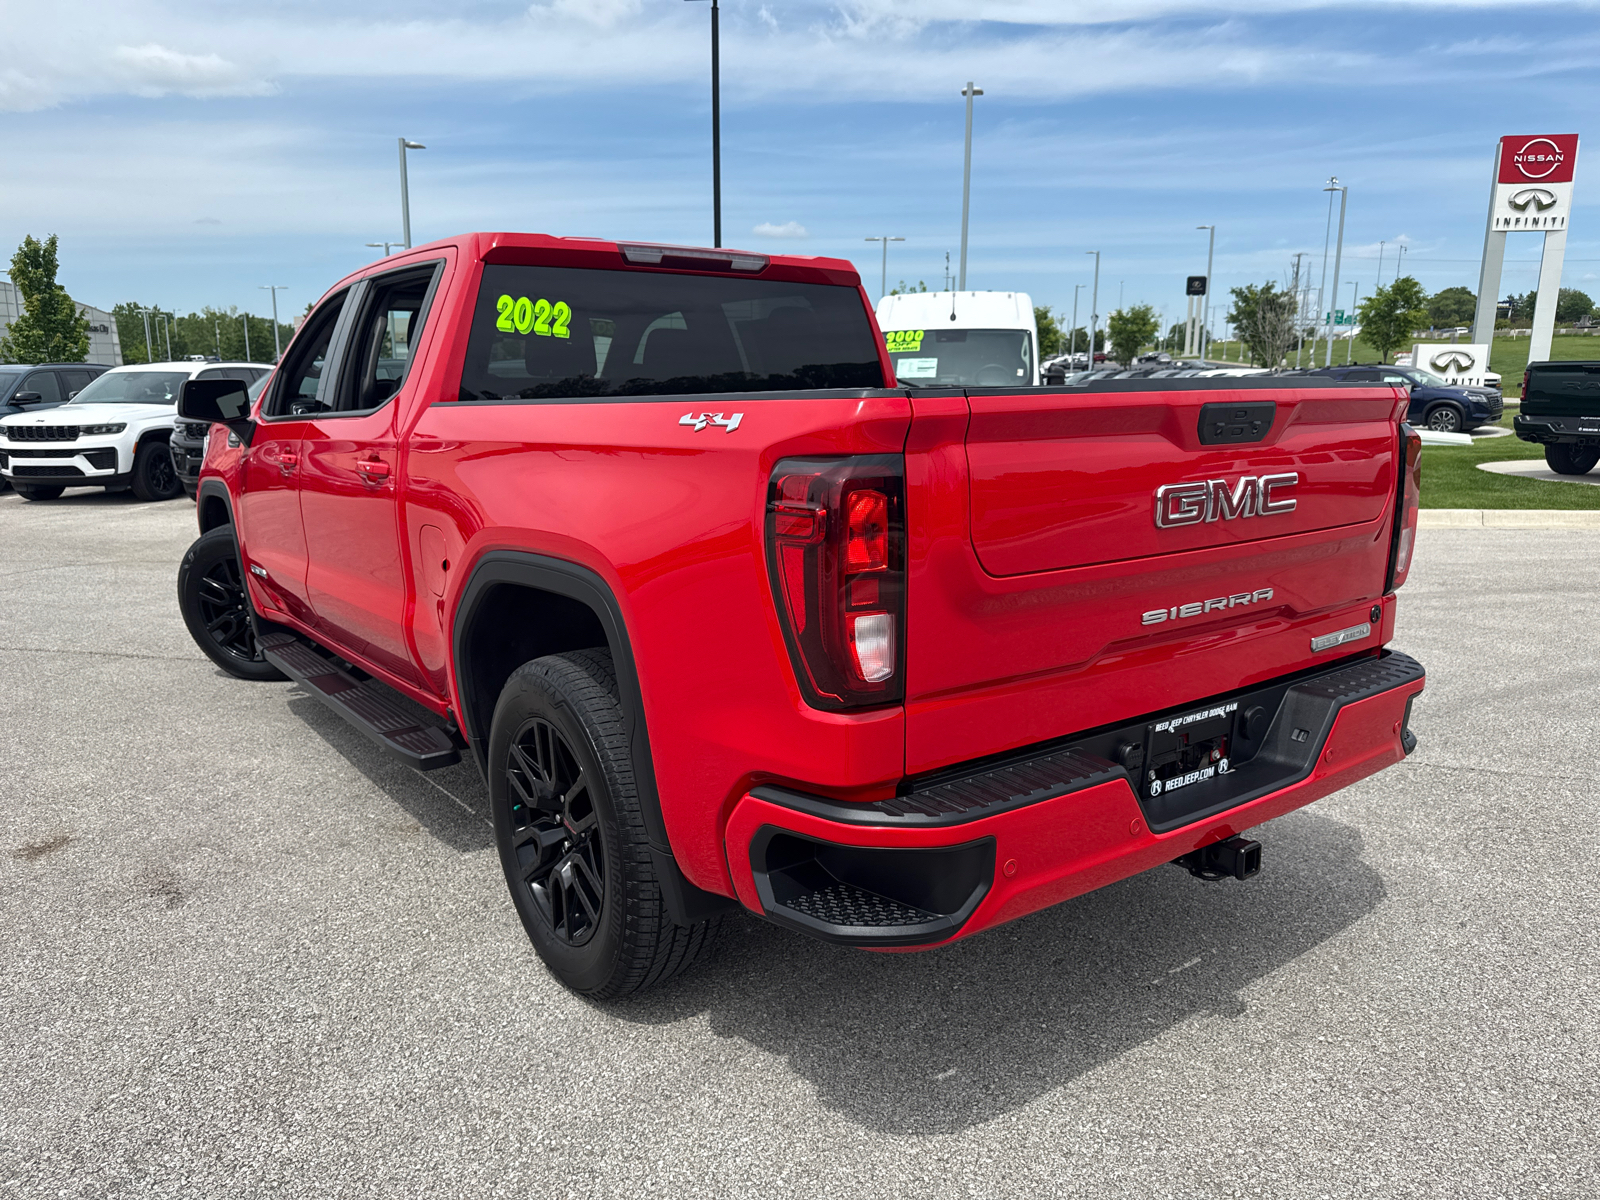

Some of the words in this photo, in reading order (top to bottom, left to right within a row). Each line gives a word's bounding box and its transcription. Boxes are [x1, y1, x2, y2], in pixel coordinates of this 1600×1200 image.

[1513, 154, 1564, 162] NISSAN
[1495, 216, 1565, 227] INFINITI
[496, 294, 571, 339] 2022
[886, 330, 924, 342] 9000
[1445, 377, 1480, 386] INITI
[1562, 381, 1600, 390] RA
[1155, 471, 1298, 529] GMC
[1141, 587, 1274, 626] SIERRA
[1316, 625, 1368, 648] ELEVATION
[1155, 721, 1170, 732] REED
[1170, 717, 1183, 728] JEEP
[1183, 710, 1209, 725] CHRYSLER
[1209, 706, 1225, 718] DODGE
[1225, 702, 1238, 713] RAM
[1165, 766, 1215, 792] REEDJEEP.COM
[604, 819, 623, 946] BRIDGESTONE
